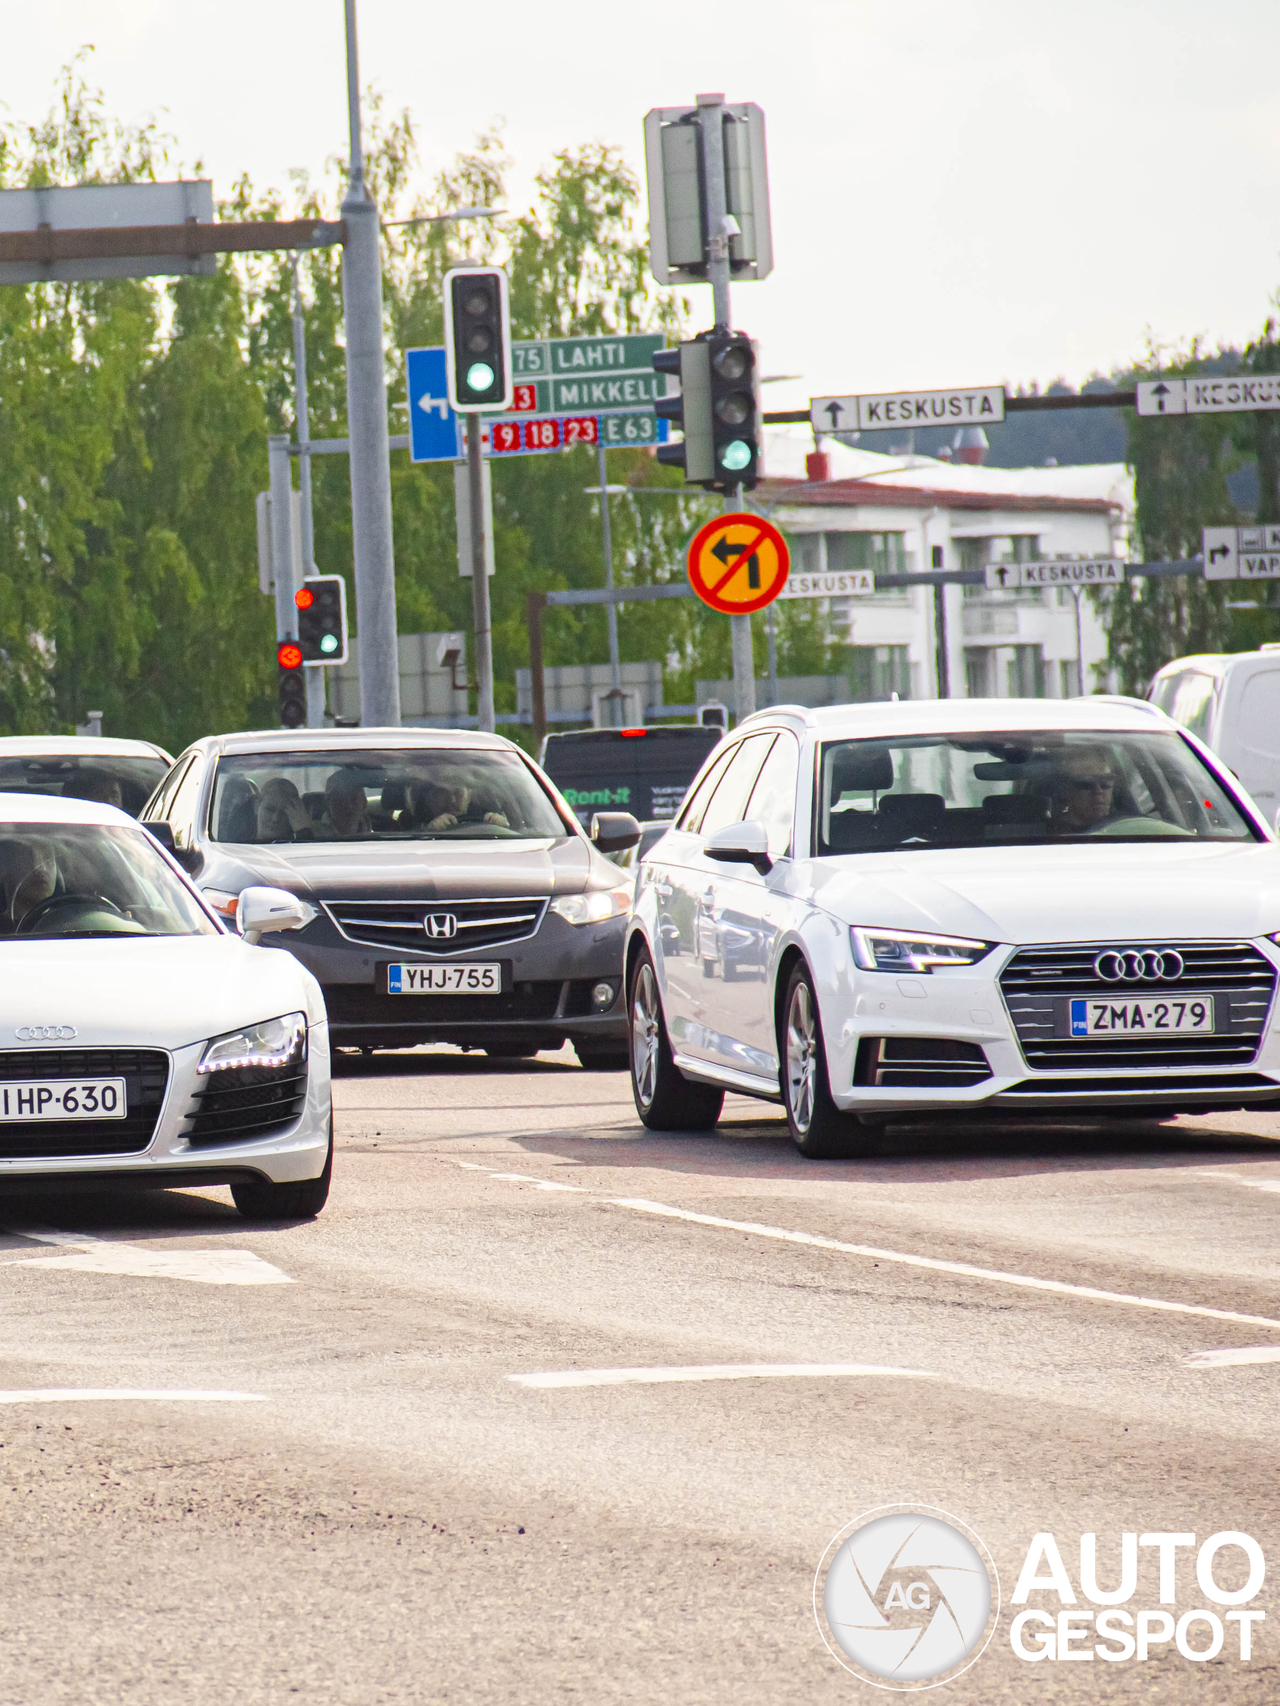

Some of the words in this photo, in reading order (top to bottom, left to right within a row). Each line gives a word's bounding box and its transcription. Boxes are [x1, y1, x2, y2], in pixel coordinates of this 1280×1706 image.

[515, 349, 541, 371] 75
[558, 344, 625, 368] LAHTI
[867, 395, 994, 422] KESKUSTA
[501, 426, 514, 448] 9
[531, 423, 554, 446] 18
[568, 420, 595, 442] 23
[607, 419, 620, 440] E
[624, 416, 652, 439] 63
[781, 575, 870, 594] ESKUSTA
[1025, 563, 1116, 581] KESKUSTA
[406, 968, 495, 989] YHJ-755
[1092, 1002, 1207, 1031] ZMA-279
[3, 1085, 117, 1115] IHP-630
